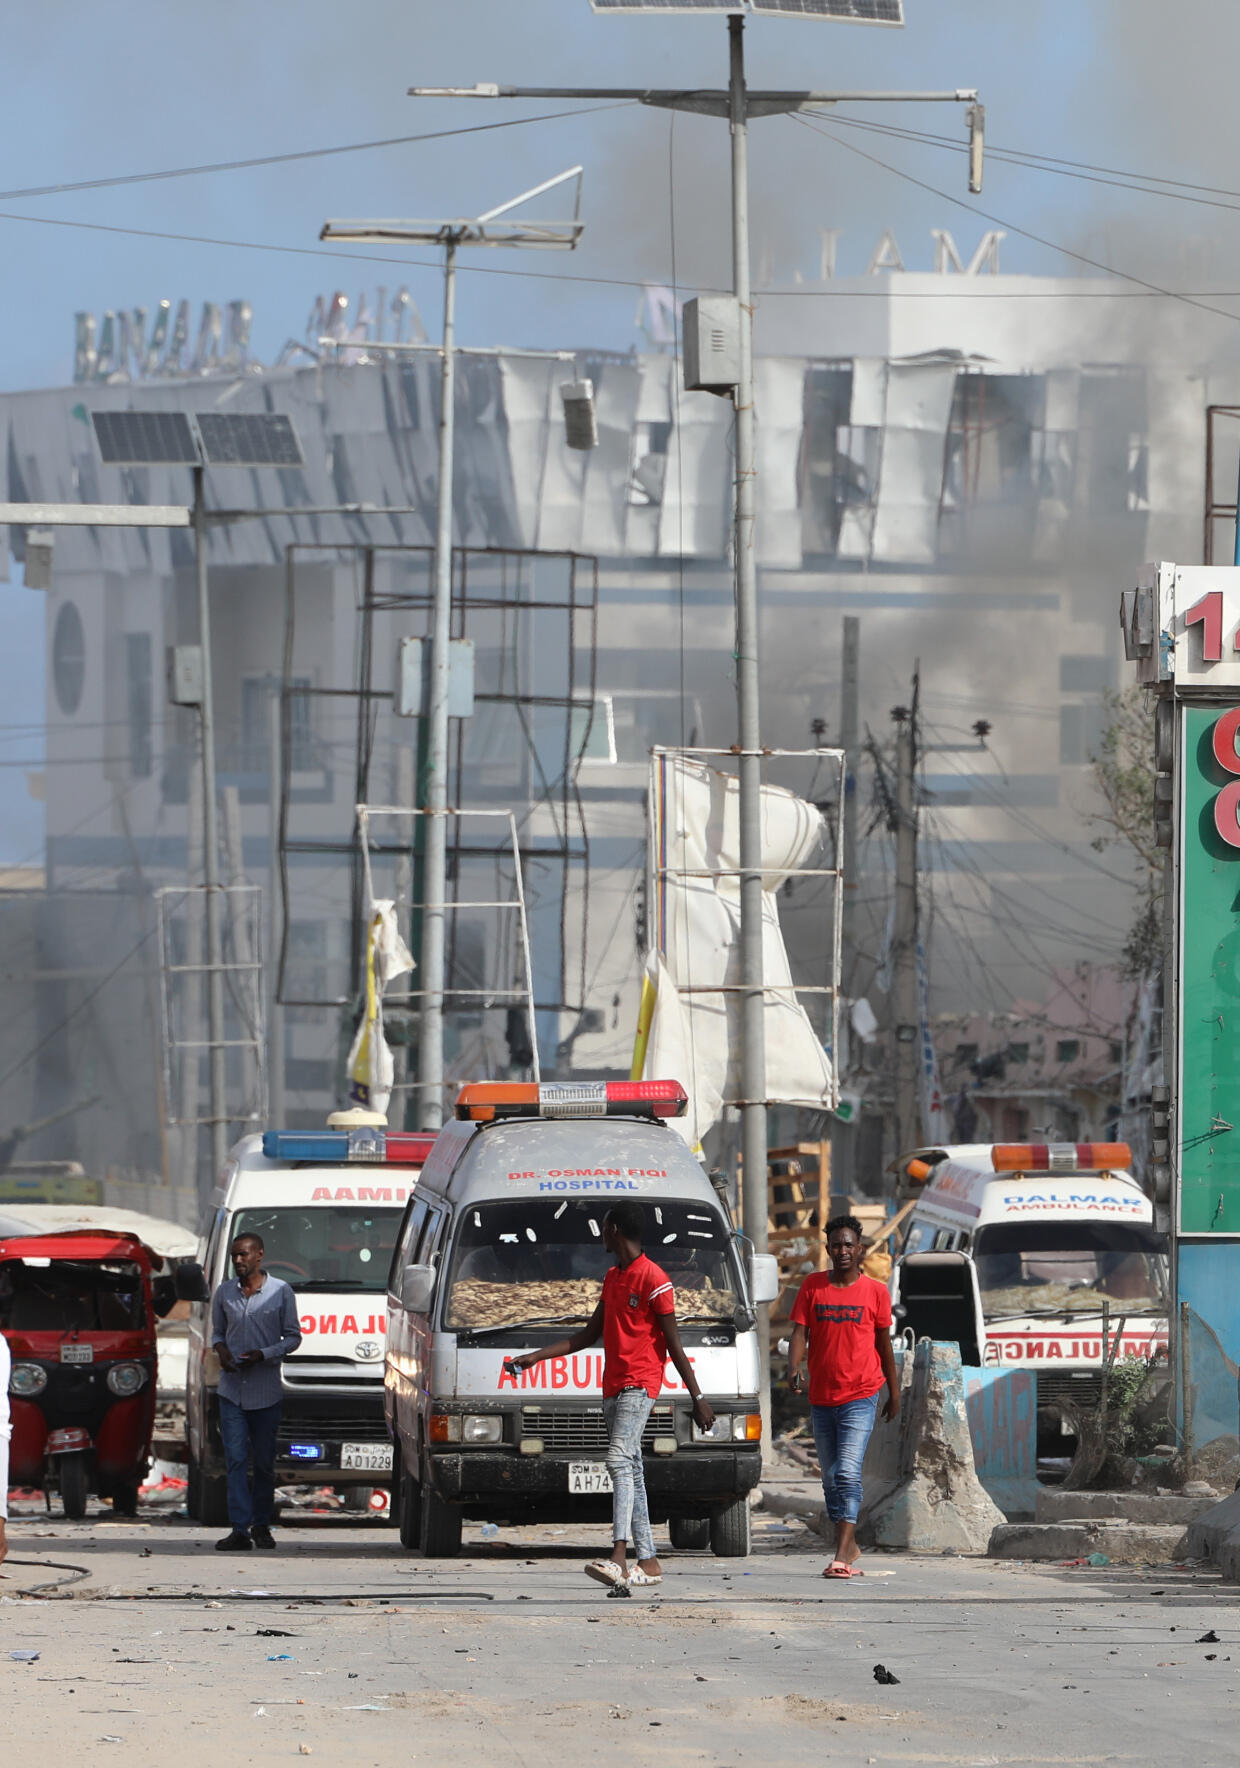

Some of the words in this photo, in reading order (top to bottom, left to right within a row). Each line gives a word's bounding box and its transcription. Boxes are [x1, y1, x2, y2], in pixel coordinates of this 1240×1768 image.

[508, 1171, 541, 1180] DR.
[547, 1168, 619, 1178] OSMAN
[539, 1179, 639, 1191] HOSPITAL
[312, 1187, 414, 1201] AAMI
[1004, 1194, 1142, 1206] DALMAR
[1006, 1203, 1144, 1215] AMBULANCE
[573, 1475, 610, 1490] AH74
